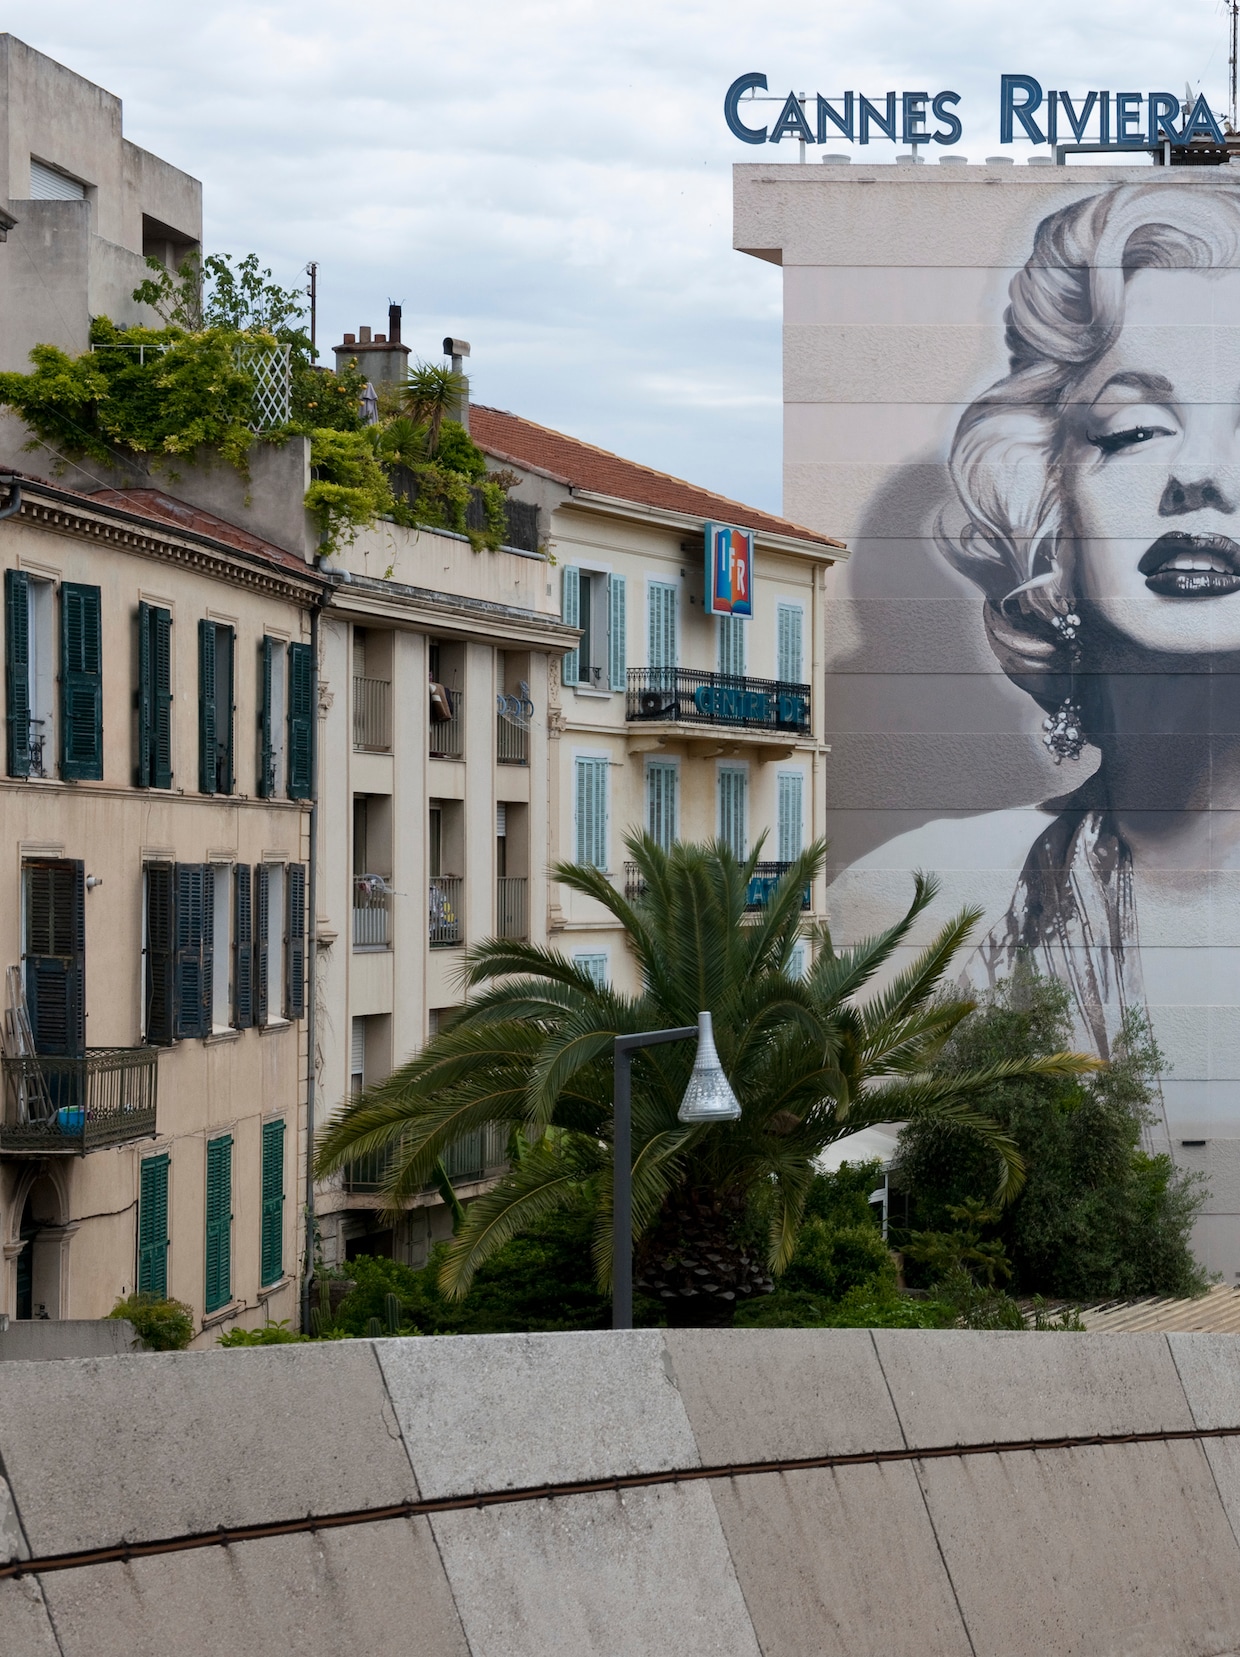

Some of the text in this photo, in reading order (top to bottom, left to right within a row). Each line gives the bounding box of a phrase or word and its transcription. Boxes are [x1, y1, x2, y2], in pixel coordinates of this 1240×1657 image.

[723, 72, 962, 145] CANNES
[1000, 73, 1227, 145] RIVIERA
[722, 537, 745, 596] IFR
[695, 686, 806, 725] CENTRE DE
